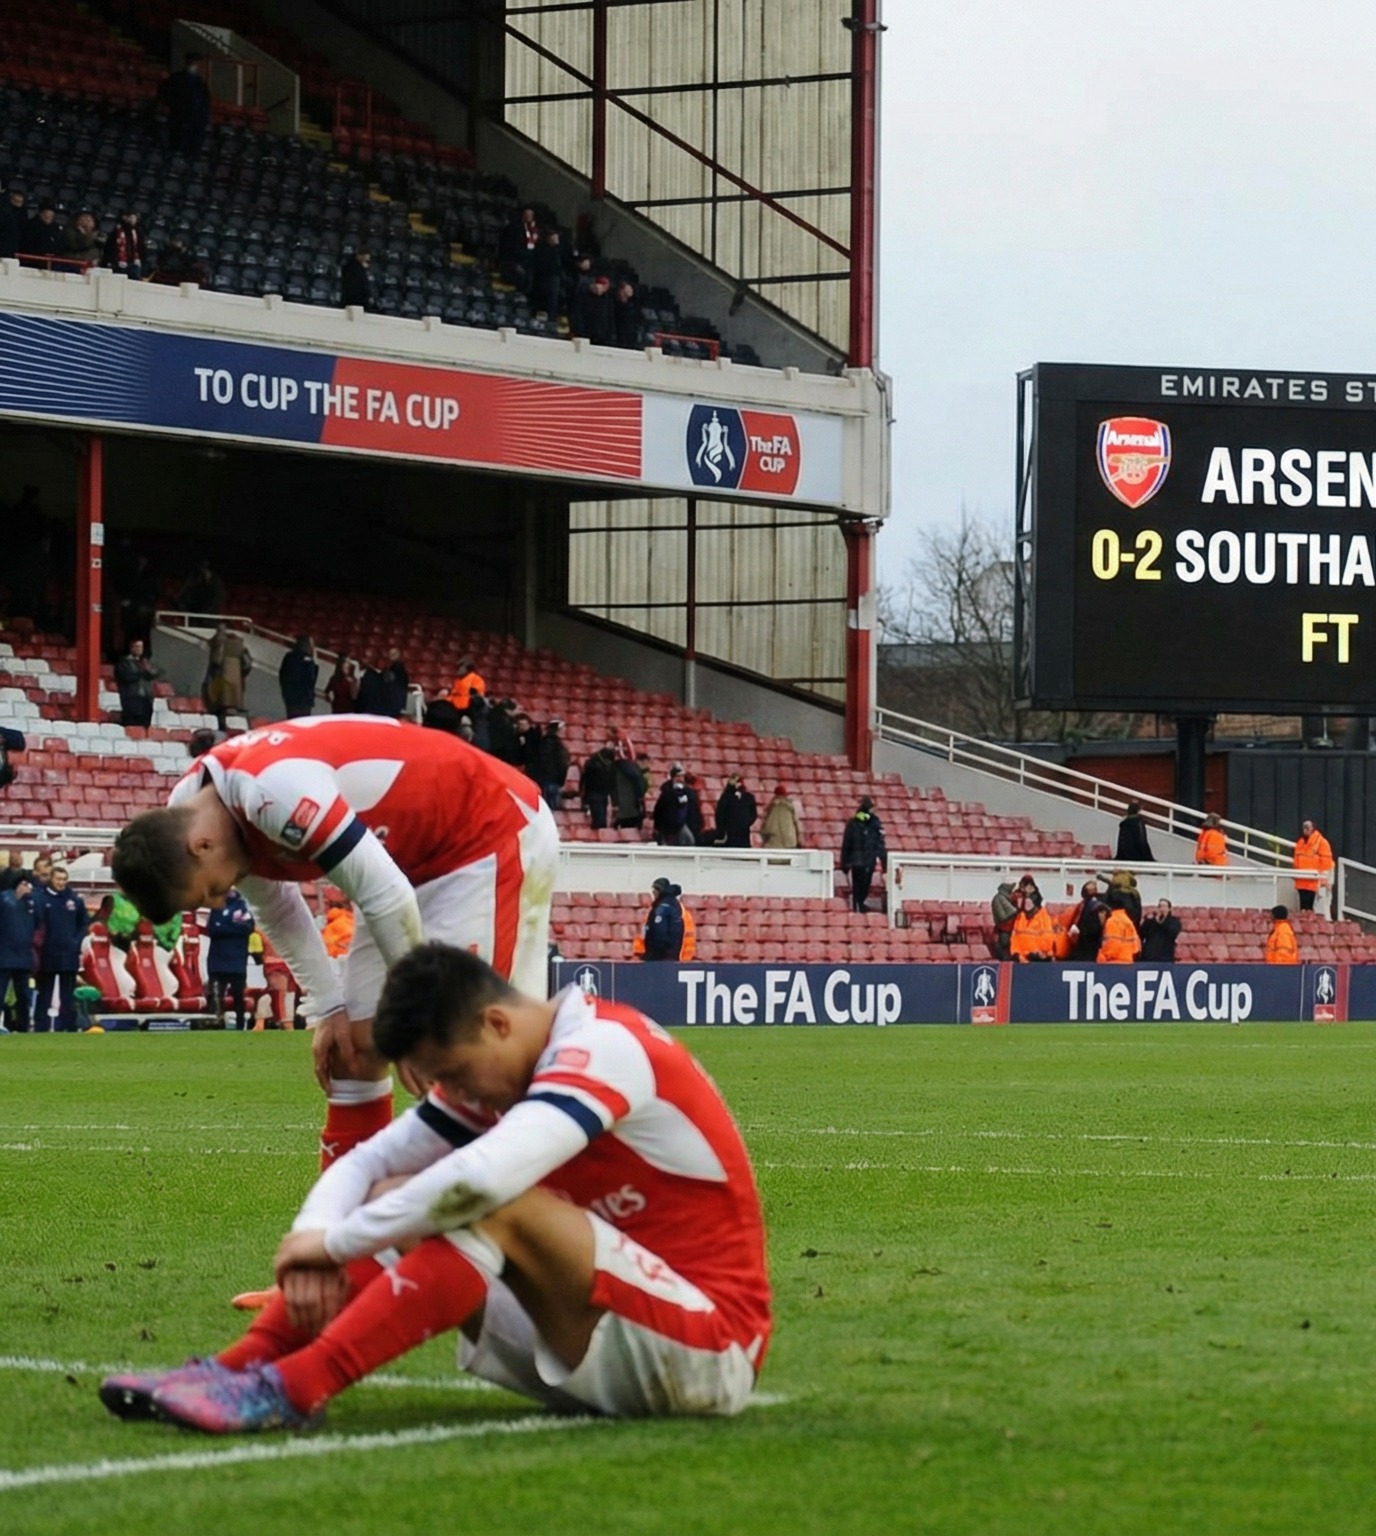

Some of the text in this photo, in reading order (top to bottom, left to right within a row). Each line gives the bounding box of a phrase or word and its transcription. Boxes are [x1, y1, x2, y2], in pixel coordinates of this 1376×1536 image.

[194, 367, 460, 430] TO CUP THE FA CUP
[1161, 374, 1329, 401] EMIRATES
[759, 455, 786, 474] CUP
[1091, 529, 1163, 581] 0-2
[1301, 612, 1360, 664] FT
[678, 969, 902, 1026] The FA Cup
[1062, 969, 1252, 1024] The FA Cup
